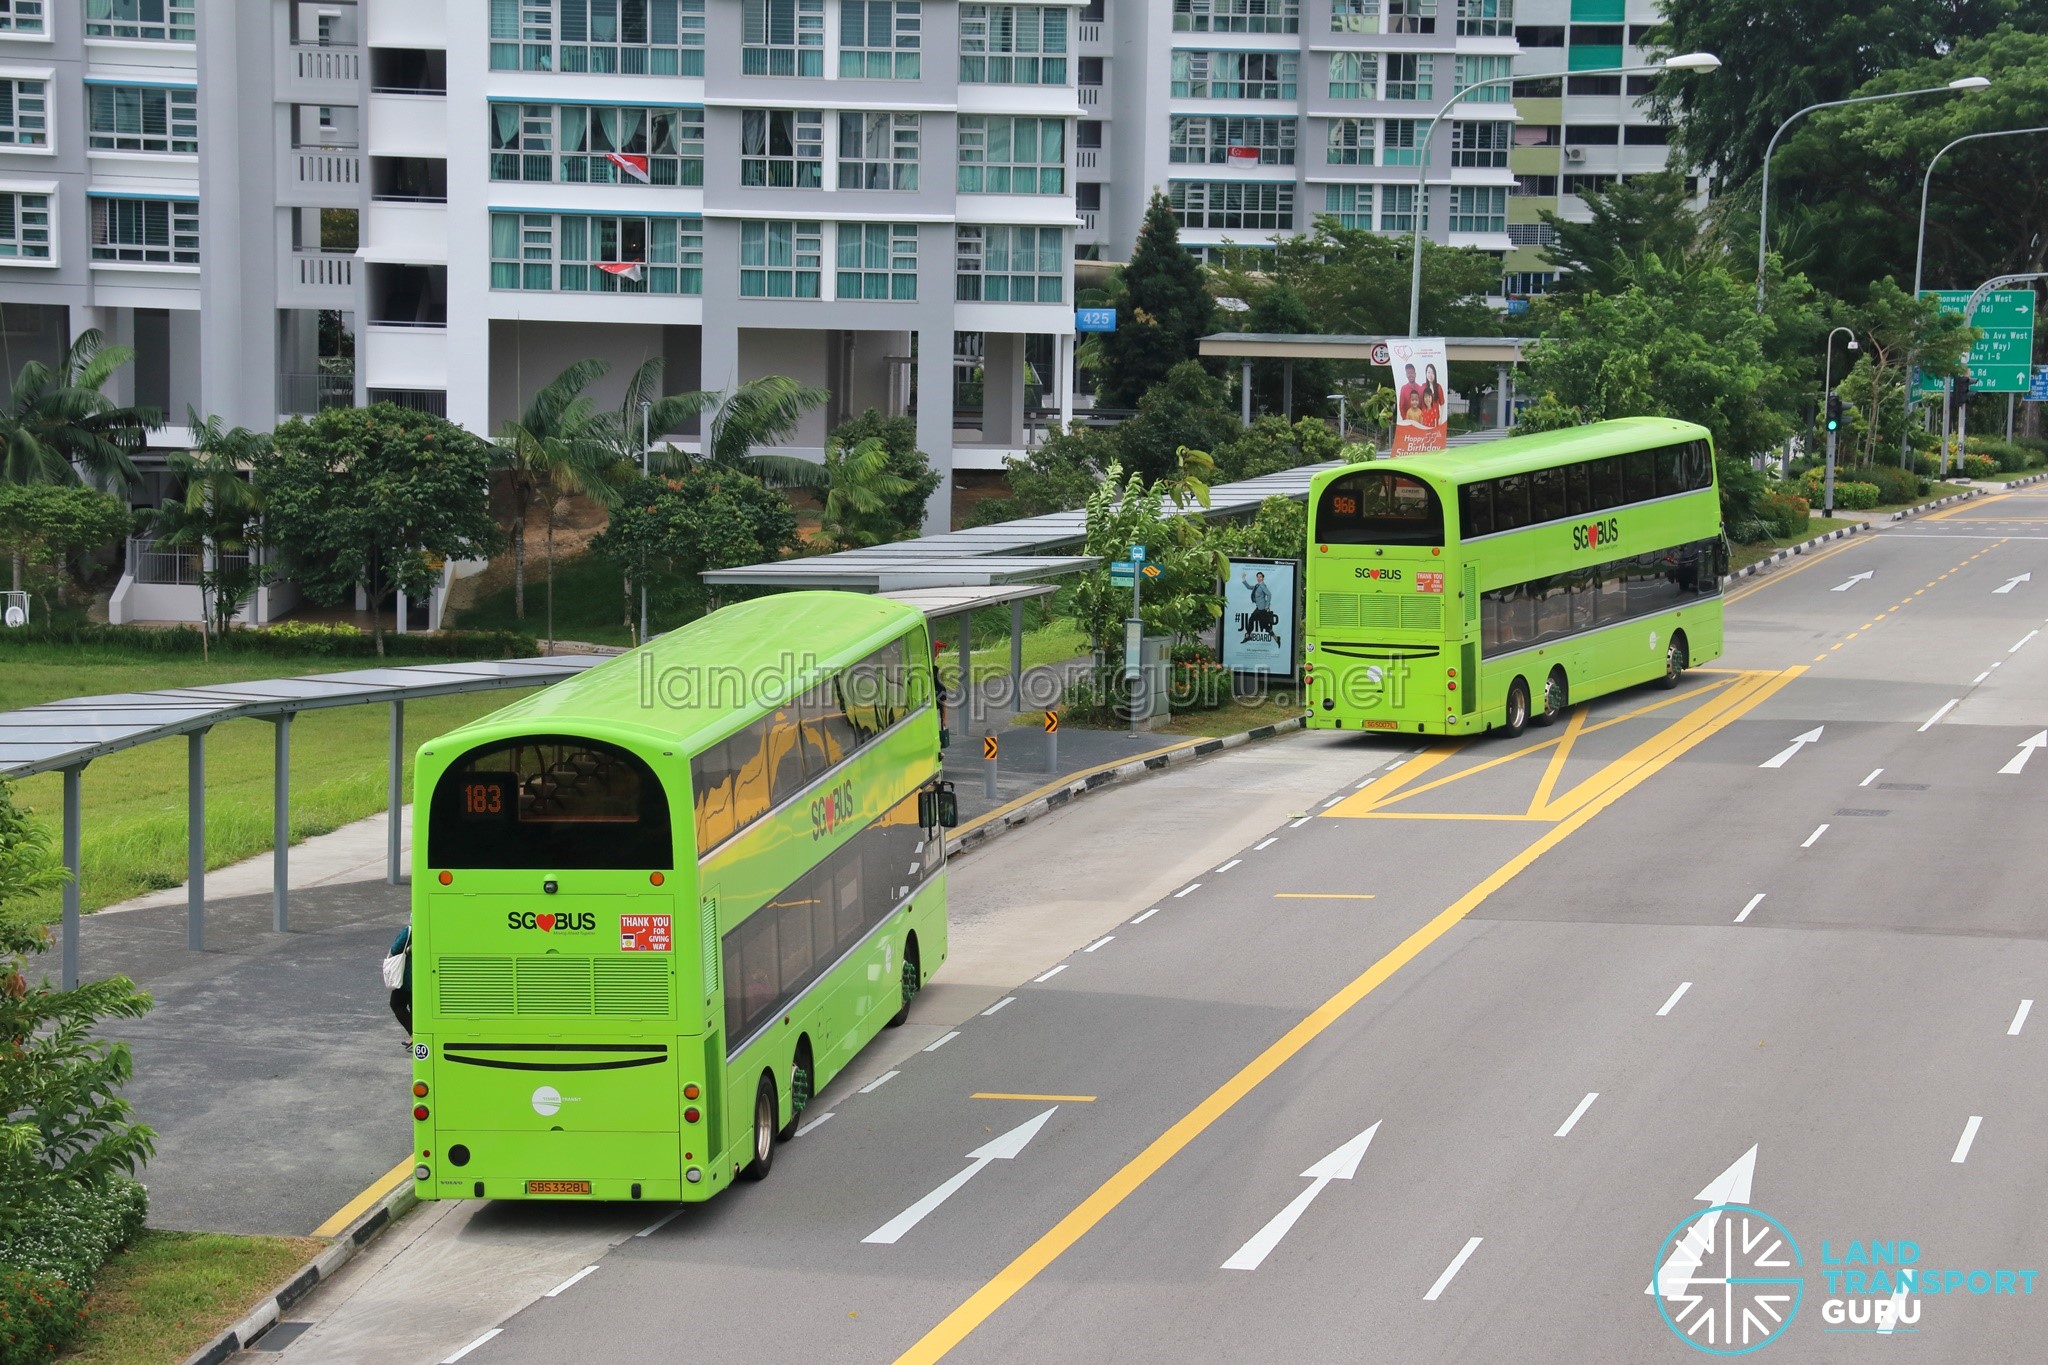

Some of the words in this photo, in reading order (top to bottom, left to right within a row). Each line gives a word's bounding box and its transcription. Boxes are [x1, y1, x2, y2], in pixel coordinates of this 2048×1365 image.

[1994, 294, 2012, 303] West
[1981, 305, 1994, 314] Rd)
[1083, 312, 1109, 325] 425
[1993, 331, 2007, 340] Ave
[2010, 331, 2028, 340] West
[1976, 342, 1989, 352] Lay
[1992, 342, 2011, 352] Way)
[1970, 352, 1984, 361] Ave
[1977, 368, 1987, 377] Rd
[1986, 378, 1996, 387] Rd
[1404, 434, 1424, 444] Happy
[1407, 442, 1441, 452] Birthday
[1596, 517, 1619, 546] BUS
[1379, 568, 1402, 581] BUS
[464, 784, 501, 813] 183
[832, 778, 854, 827] BUS
[554, 912, 597, 931] BUS
[621, 916, 650, 927] THANK
[652, 916, 669, 927] YOU
[653, 927, 665, 935] FOR
[648, 935, 670, 943] GIVING
[652, 943, 666, 951] WAY
[416, 1045, 427, 1055] 60
[530, 1182, 588, 1193] SBS3328L
